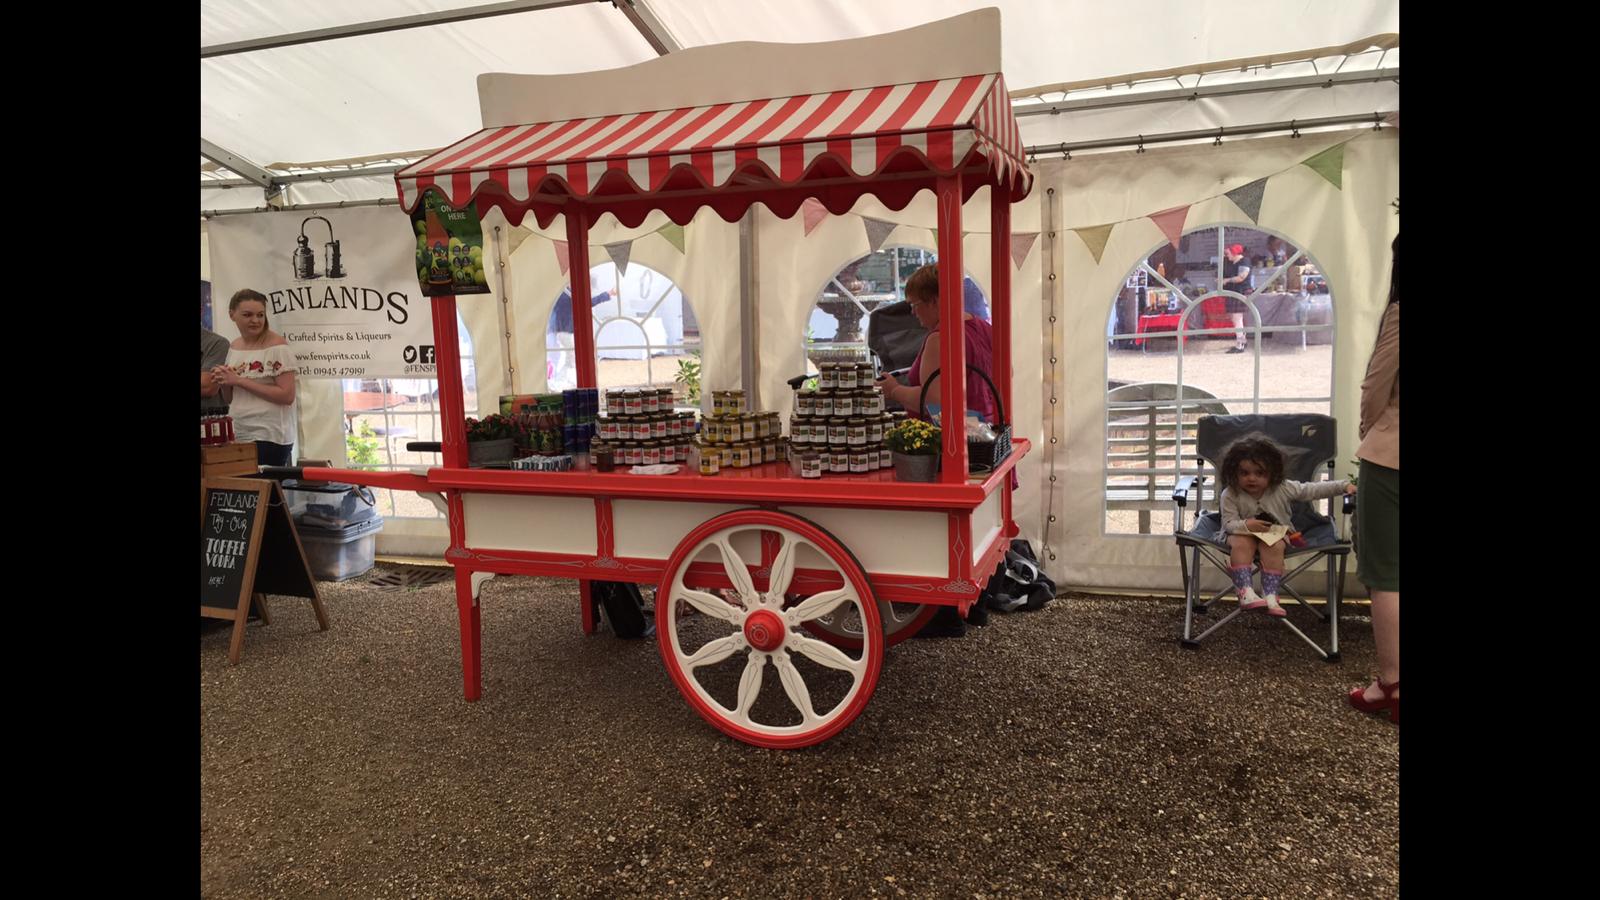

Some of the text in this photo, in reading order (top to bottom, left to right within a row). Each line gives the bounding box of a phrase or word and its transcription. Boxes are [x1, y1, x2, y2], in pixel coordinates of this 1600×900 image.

[447, 212, 467, 221] HERE
[269, 286, 409, 325] ENLANDS
[287, 332, 316, 342] Crafted
[317, 332, 345, 344] Spirits
[346, 332, 354, 341] &
[355, 332, 392, 343] Liqueurs
[295, 350, 372, 363] ww.fenspirits.co.uk
[298, 366, 365, 376] Tel: 01945 479191
[206, 538, 247, 556] TOFFEE
[206, 553, 236, 569] VODKA
